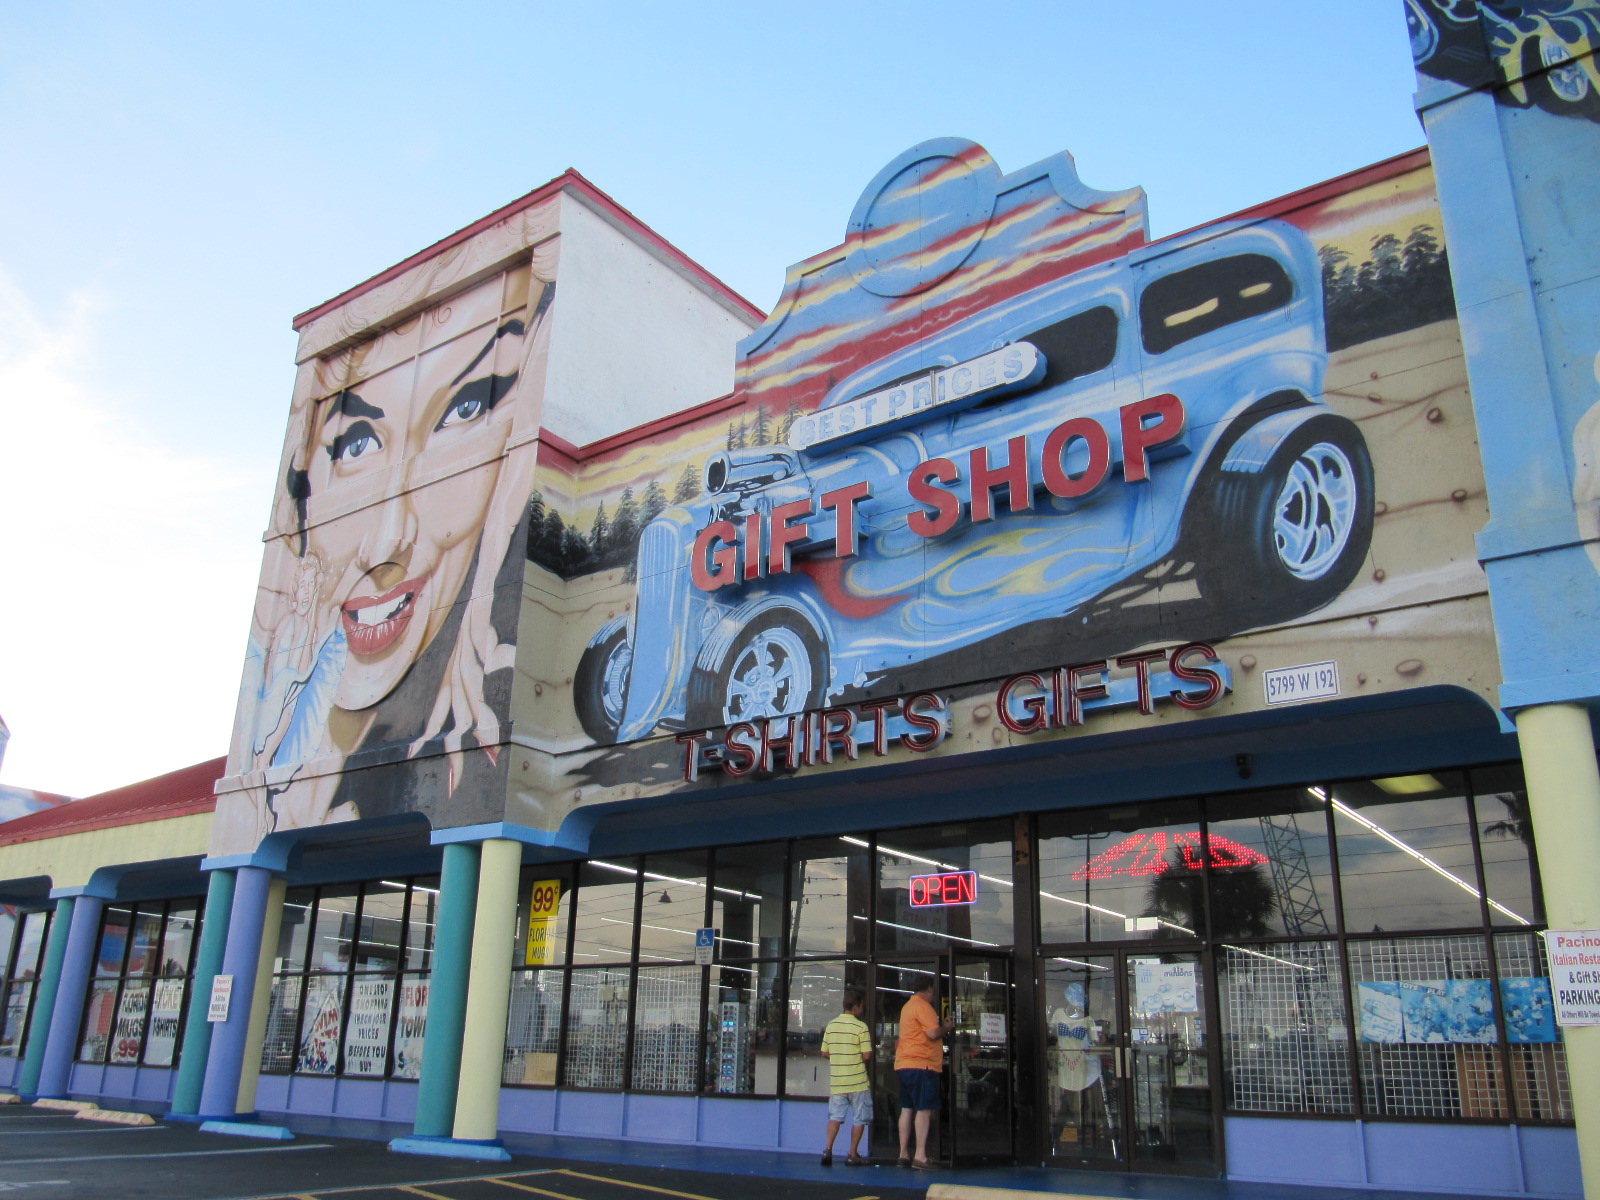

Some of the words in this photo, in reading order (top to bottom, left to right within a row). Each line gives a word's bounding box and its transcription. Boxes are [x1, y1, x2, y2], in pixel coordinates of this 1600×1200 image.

[800, 398, 877, 446] BEST
[889, 351, 1022, 417] PRICES
[691, 481, 874, 592] GIFT
[907, 393, 1186, 538] SHOP
[997, 642, 1227, 735] GIFTS
[1269, 674, 1295, 696] 5799
[1297, 672, 1310, 692] W
[1315, 669, 1335, 690] 192
[675, 692, 945, 782] T-SHIRTS
[911, 874, 975, 905] OPEN
[531, 946, 550, 960] MUGS
[1552, 953, 1578, 966] Italian
[1164, 966, 1193, 978] minions
[1569, 971, 1576, 984] &
[1576, 970, 1592, 984] Gift
[374, 983, 388, 996] STOP
[1560, 989, 1600, 1006] PARKING
[358, 1028, 379, 1040] PRICES
[348, 1045, 371, 1058] BEFORE
[372, 1045, 386, 1058] YOU
[359, 1060, 372, 1073] BUY
